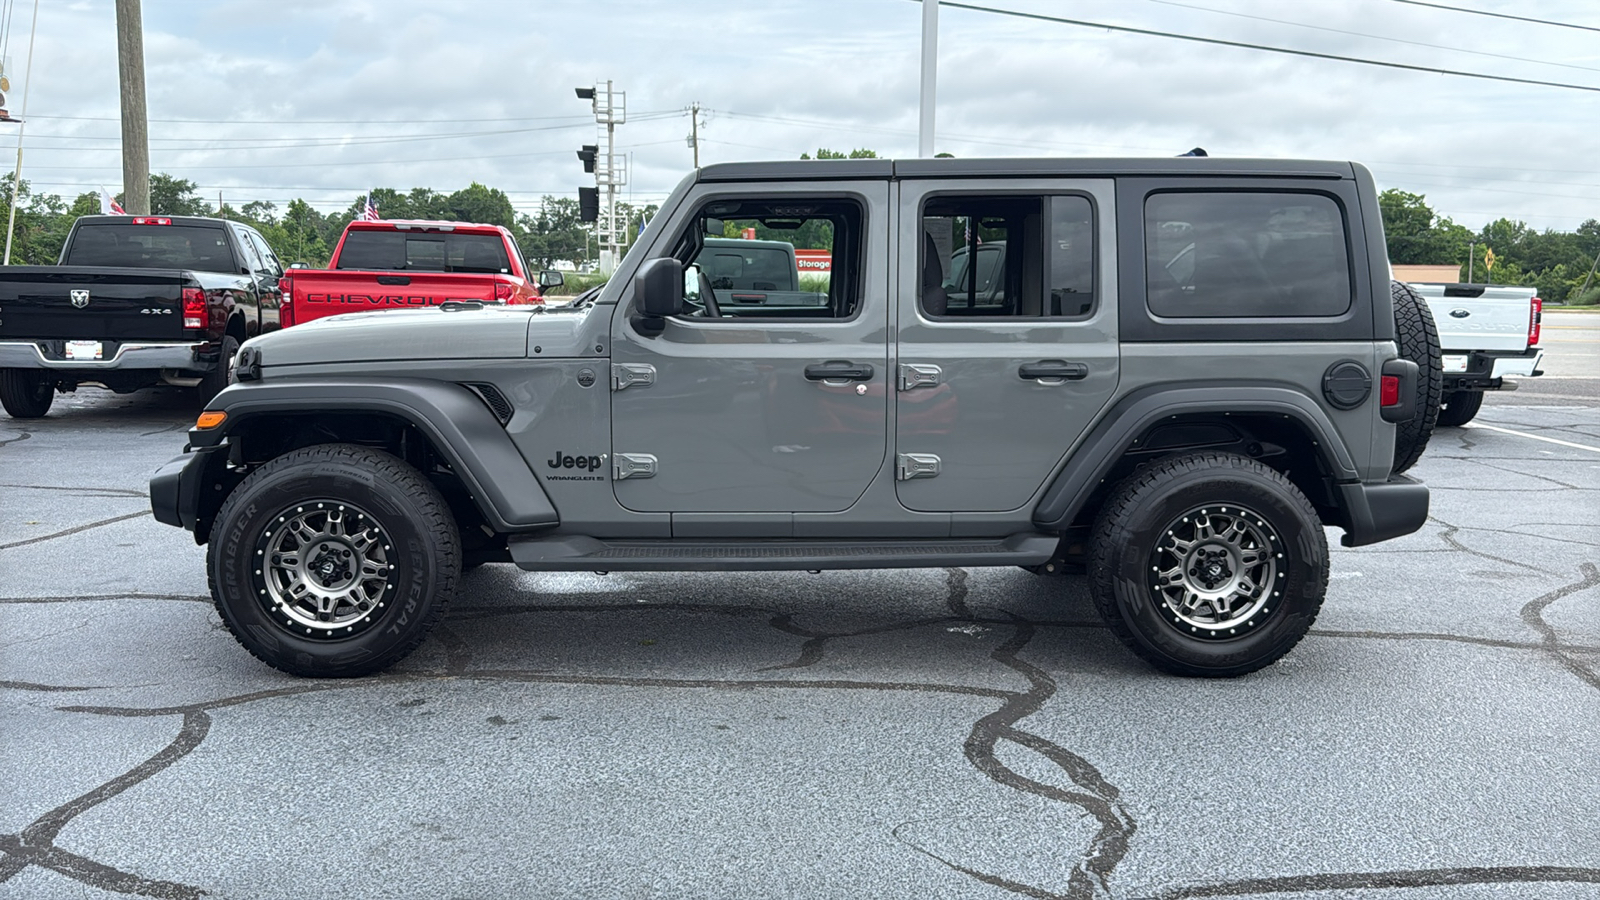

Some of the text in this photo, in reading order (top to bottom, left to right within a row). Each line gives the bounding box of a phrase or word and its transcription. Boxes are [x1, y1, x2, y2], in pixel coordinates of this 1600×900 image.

[798, 259, 830, 270] Storage
[307, 293, 480, 307] CHEVROL
[548, 451, 601, 472] Jeep
[225, 503, 258, 600] GRABBER
[386, 537, 424, 635] GENERAL
